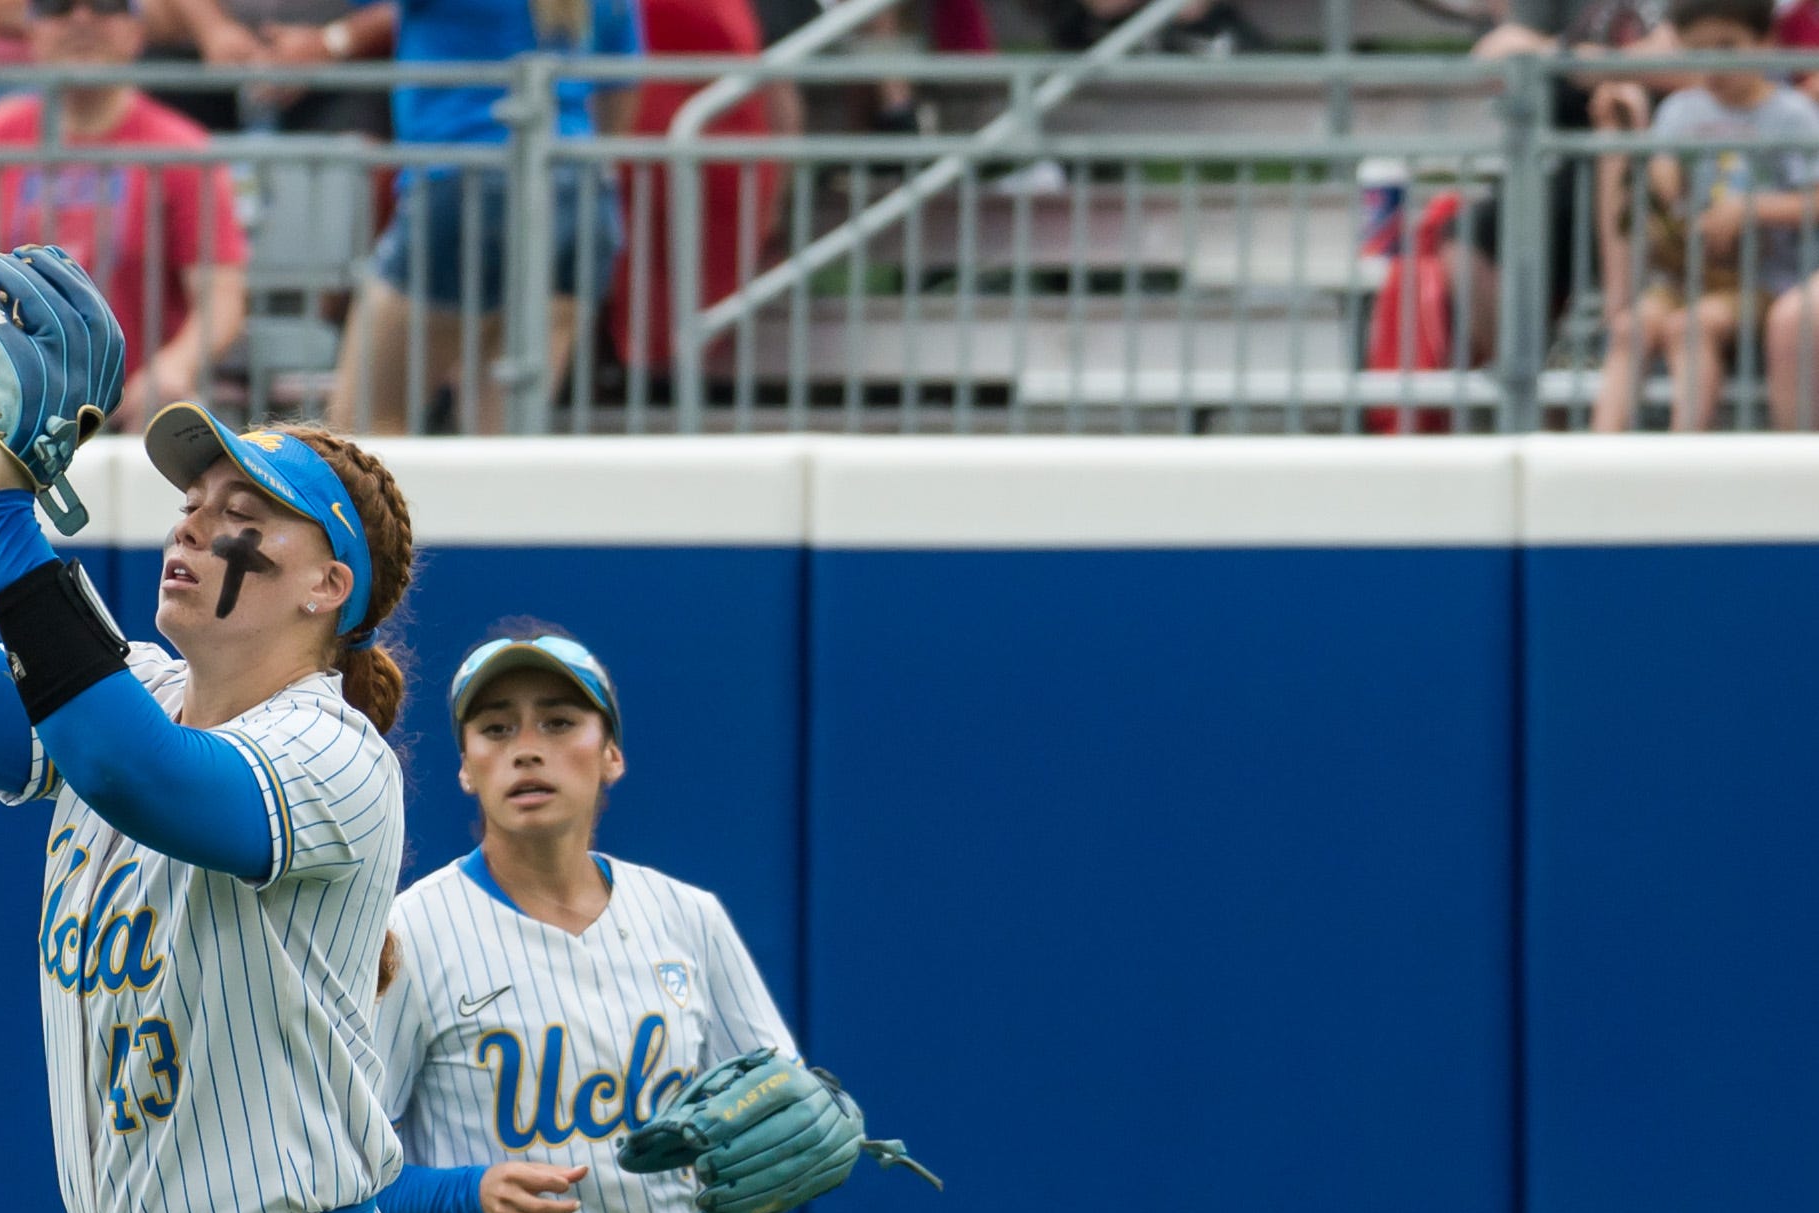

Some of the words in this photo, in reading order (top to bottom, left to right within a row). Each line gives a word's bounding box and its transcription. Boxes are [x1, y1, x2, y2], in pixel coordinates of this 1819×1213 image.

[243, 456, 296, 500] SOFTBALL
[97, 1016, 182, 1135] 43
[723, 1071, 790, 1121] EASTON
